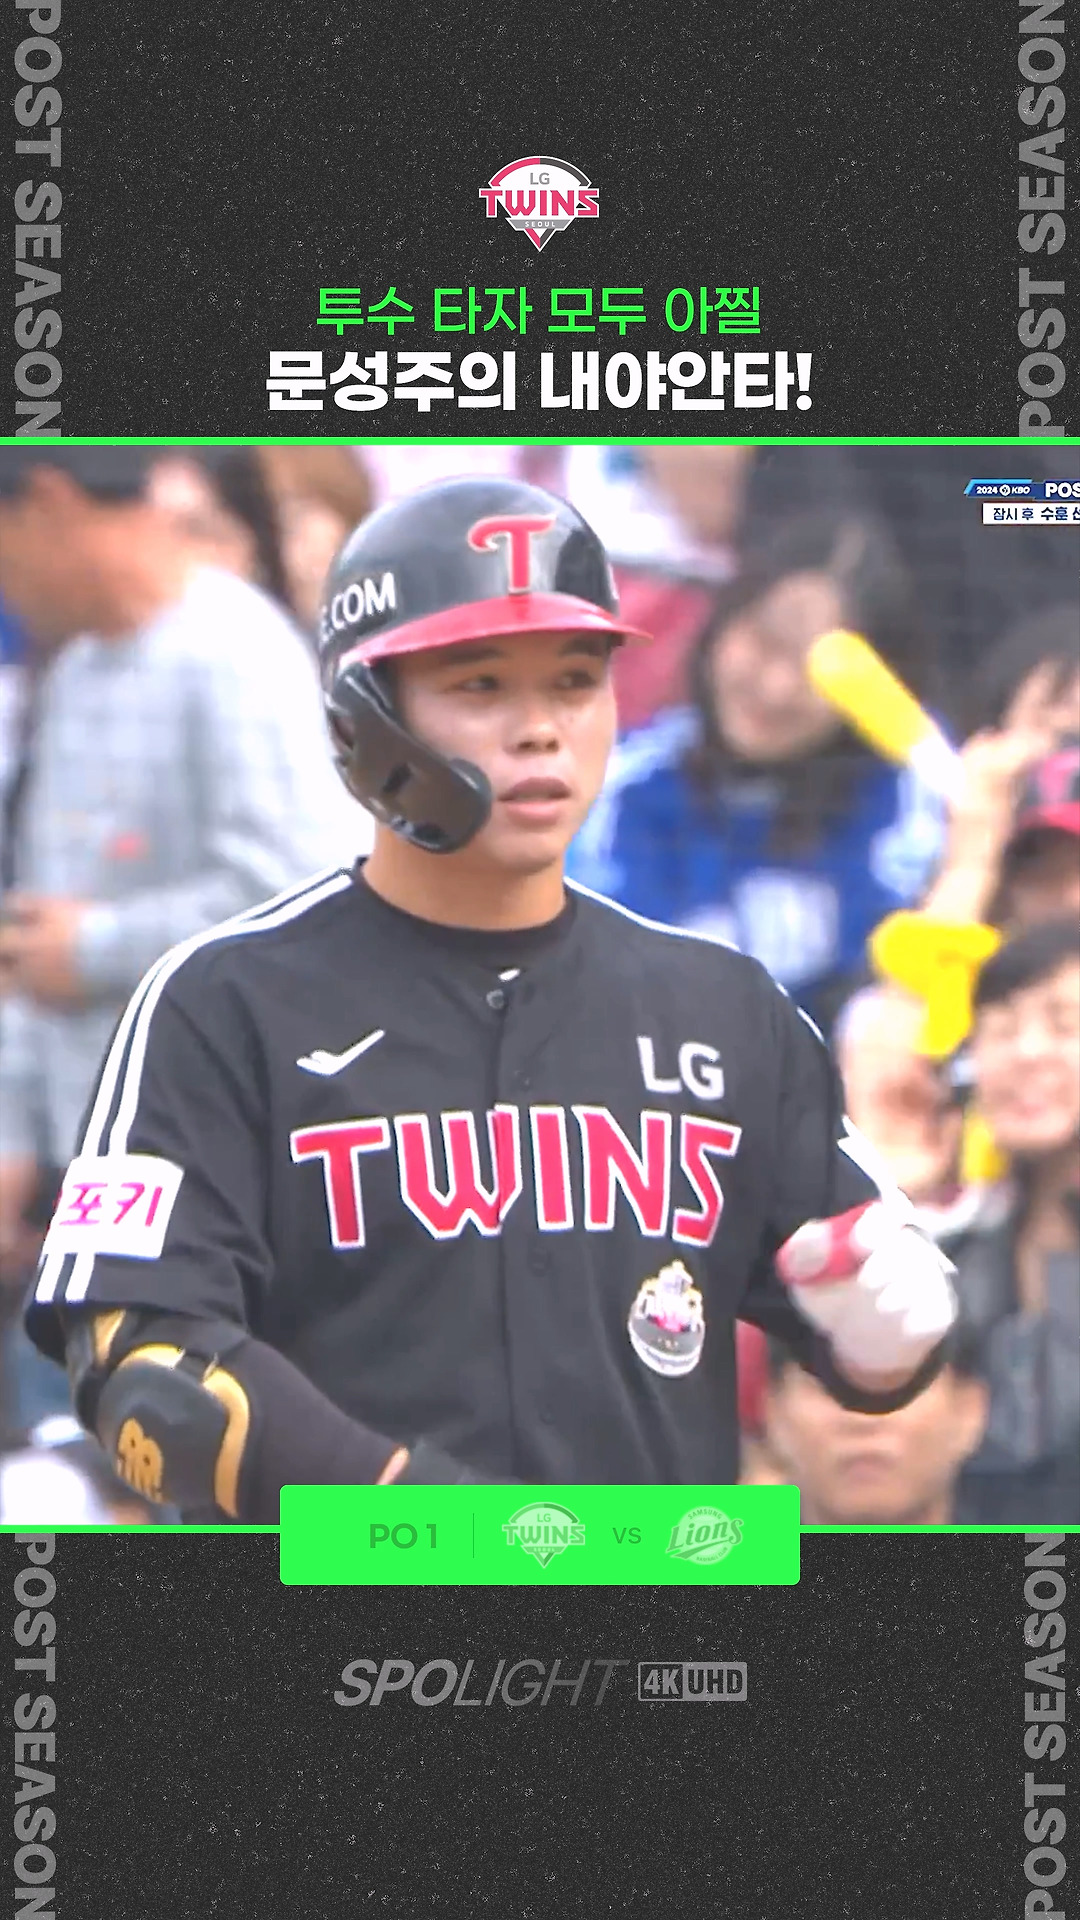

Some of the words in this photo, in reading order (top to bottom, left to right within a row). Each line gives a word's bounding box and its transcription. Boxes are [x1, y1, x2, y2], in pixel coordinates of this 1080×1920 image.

[468, 514, 557, 594] T
[637, 1035, 725, 1100] LG
[47, 1181, 163, 1227] 포키
[290, 1103, 742, 1249] TWINS
